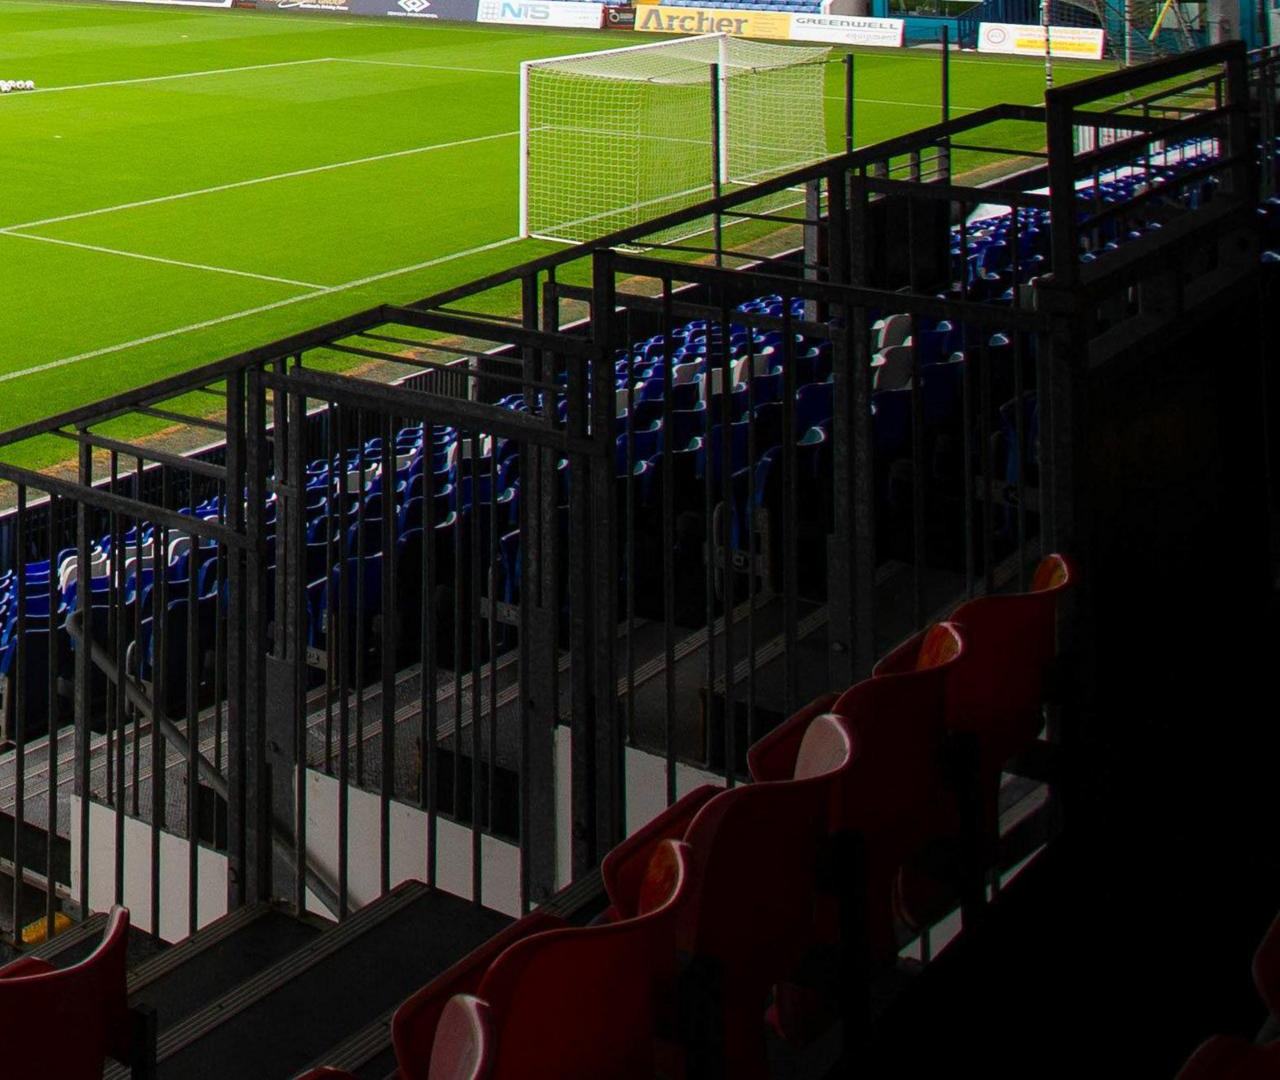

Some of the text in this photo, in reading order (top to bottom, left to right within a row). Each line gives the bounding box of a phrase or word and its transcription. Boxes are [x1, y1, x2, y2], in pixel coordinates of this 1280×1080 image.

[500, 2, 550, 20] NTS
[640, 8, 749, 35] Archer
[795, 17, 899, 30] GREENWELL
